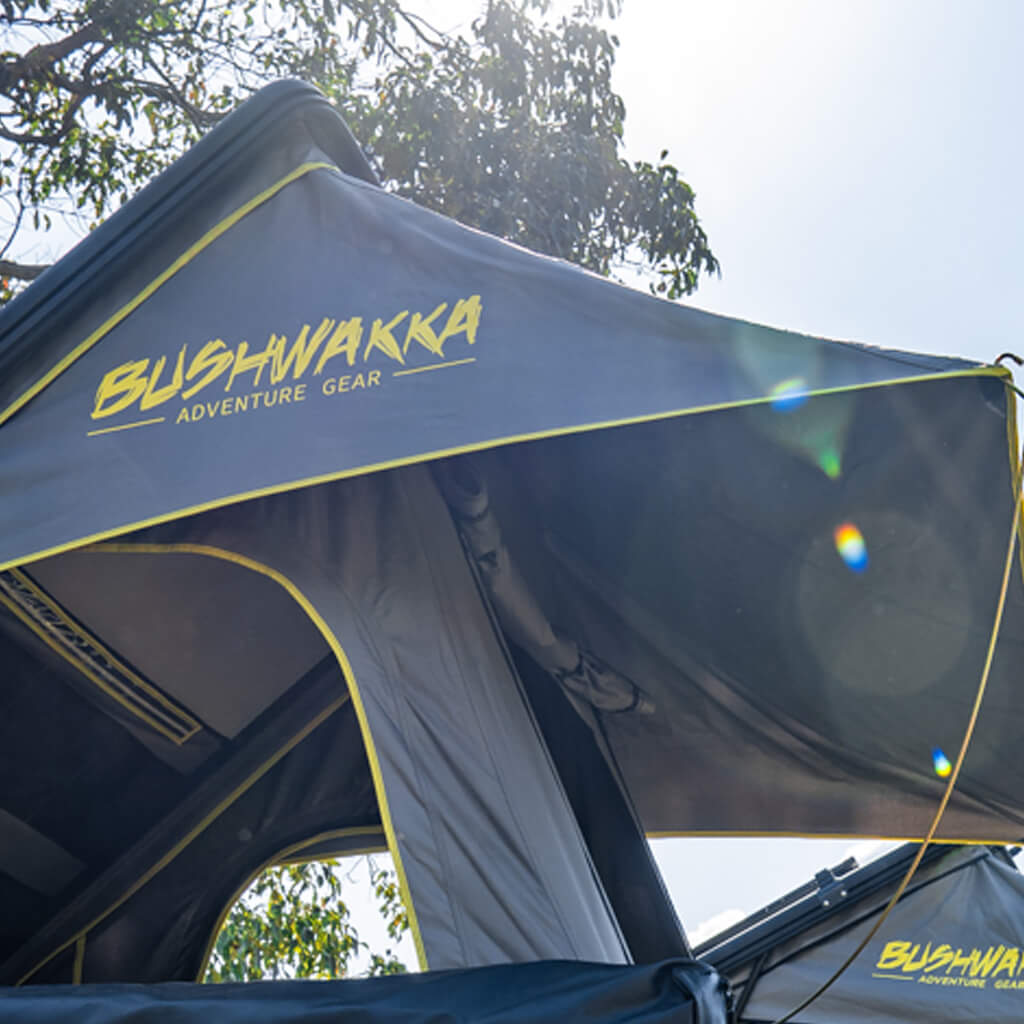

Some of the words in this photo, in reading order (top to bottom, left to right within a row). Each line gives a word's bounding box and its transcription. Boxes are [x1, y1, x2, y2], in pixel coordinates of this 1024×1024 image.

[90, 295, 482, 420] BUSHWAKKA
[175, 384, 307, 424] ADVENTURE
[321, 369, 382, 397] GEAR
[918, 975, 986, 989] ADVENTURE
